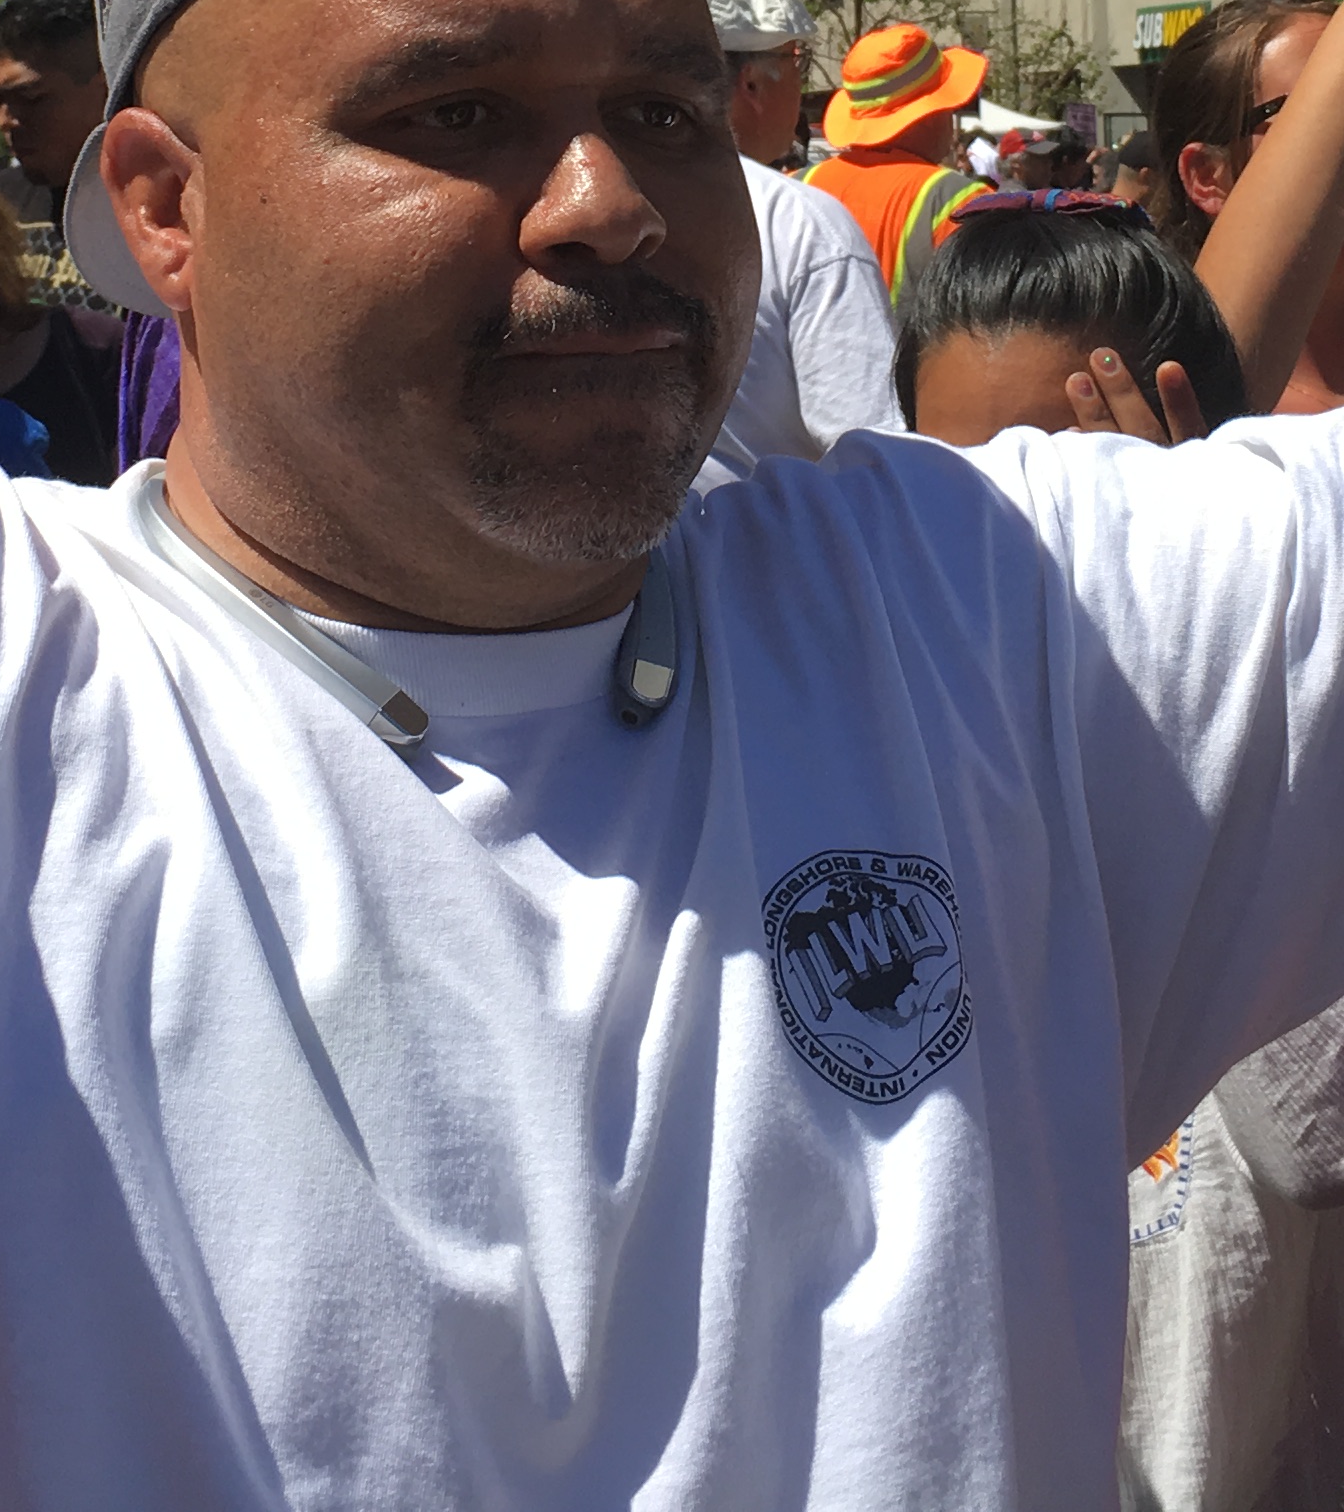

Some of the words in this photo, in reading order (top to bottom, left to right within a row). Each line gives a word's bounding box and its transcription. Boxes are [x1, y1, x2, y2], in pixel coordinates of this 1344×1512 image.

[763, 855, 863, 950] LONGSHORE
[870, 858, 888, 874] &
[925, 992, 972, 1066] UNION
[786, 892, 949, 1023] ILWU
